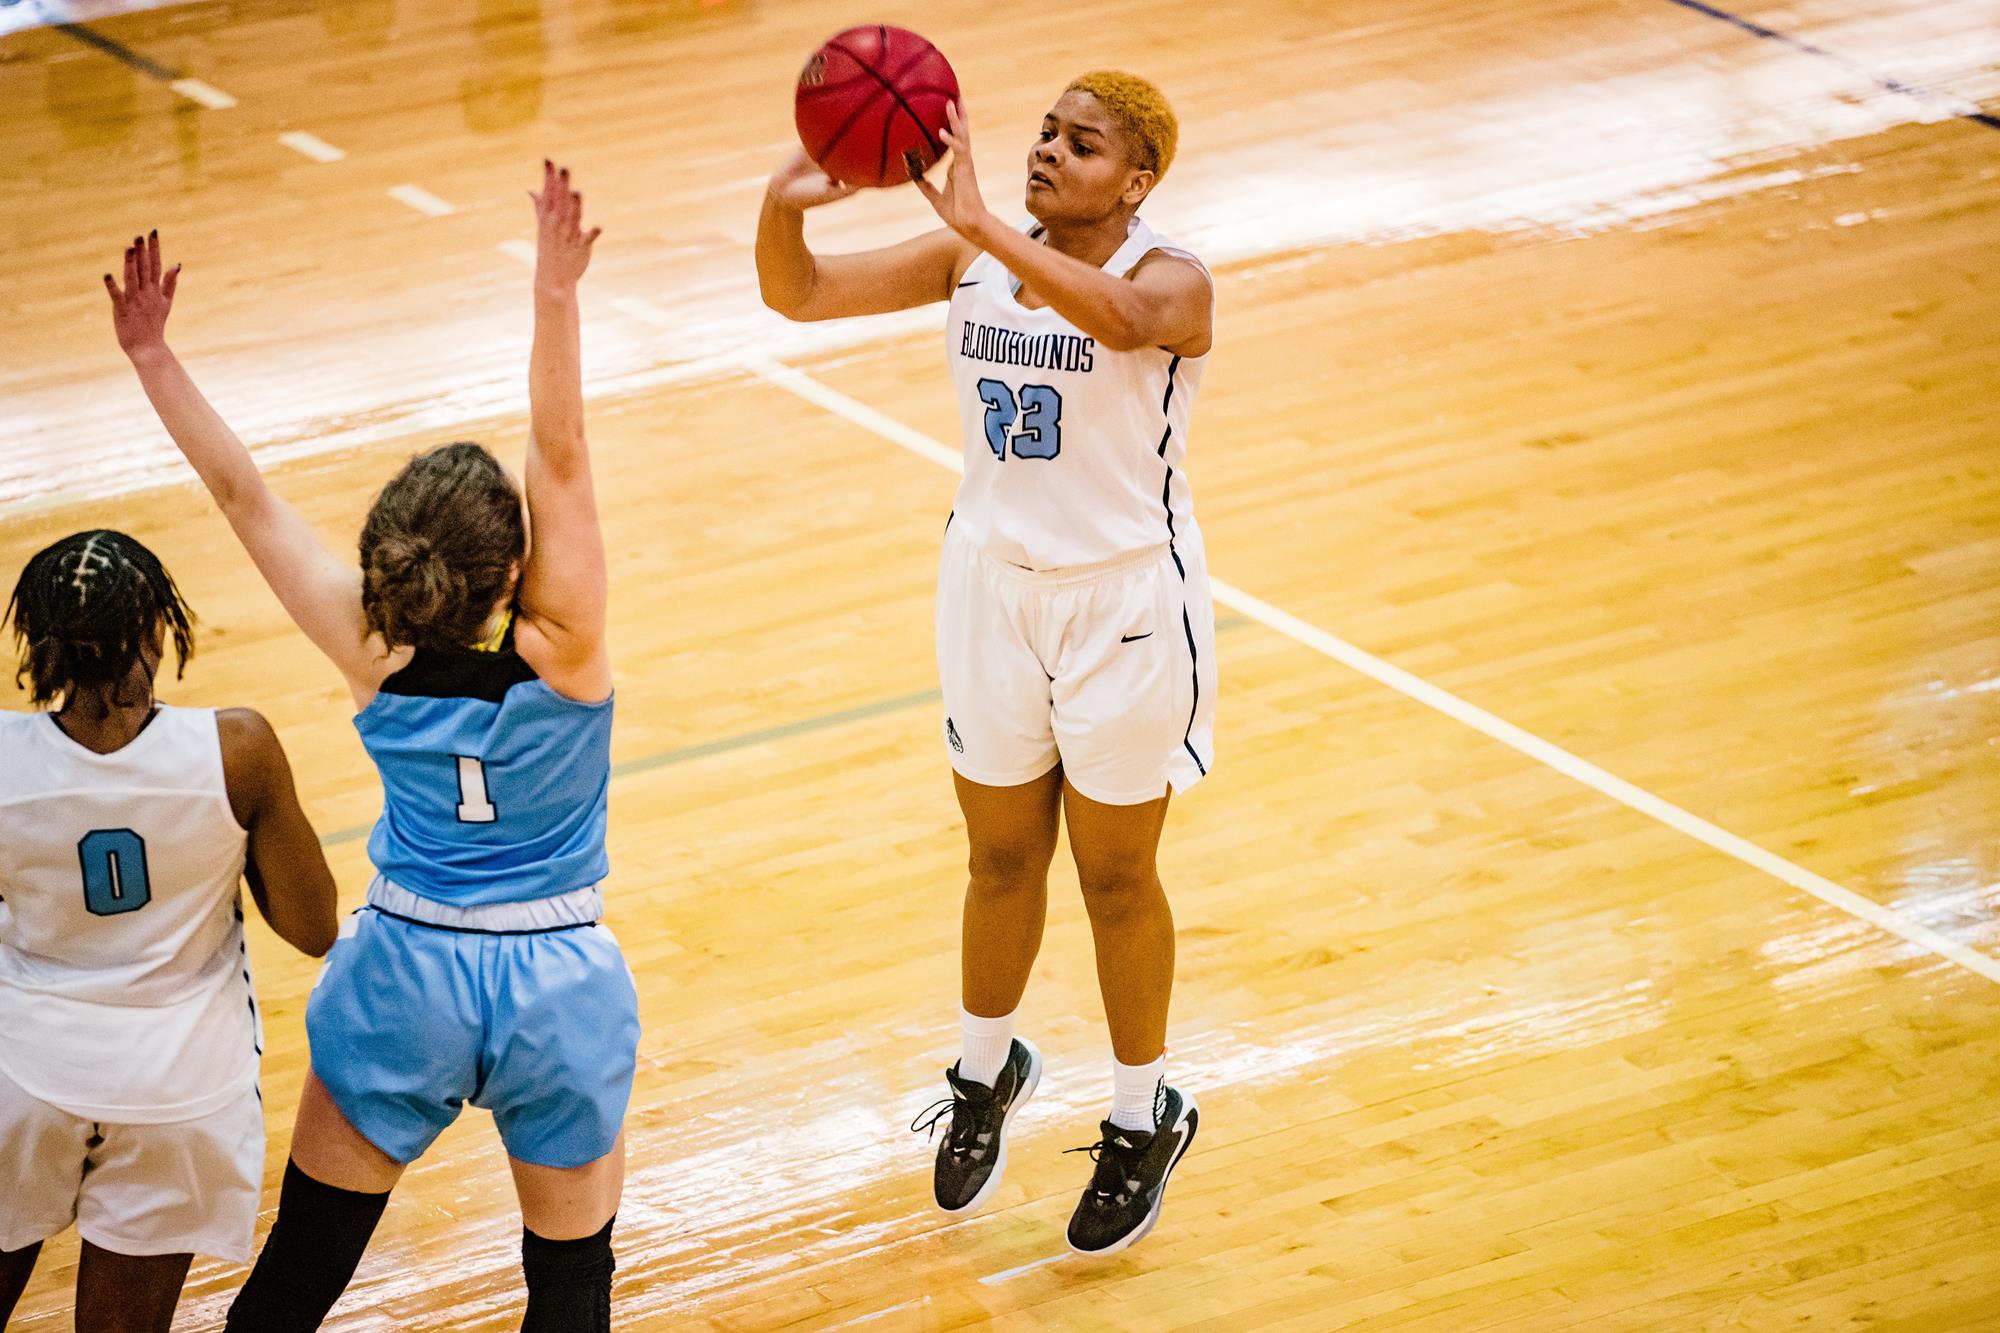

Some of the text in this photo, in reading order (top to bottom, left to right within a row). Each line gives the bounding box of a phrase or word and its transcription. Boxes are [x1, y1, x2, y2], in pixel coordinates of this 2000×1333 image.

[960, 320, 1095, 373] BLOODHOUNDS
[976, 377, 1063, 462] 23
[447, 753, 499, 824] 1
[77, 828, 152, 917] 0
